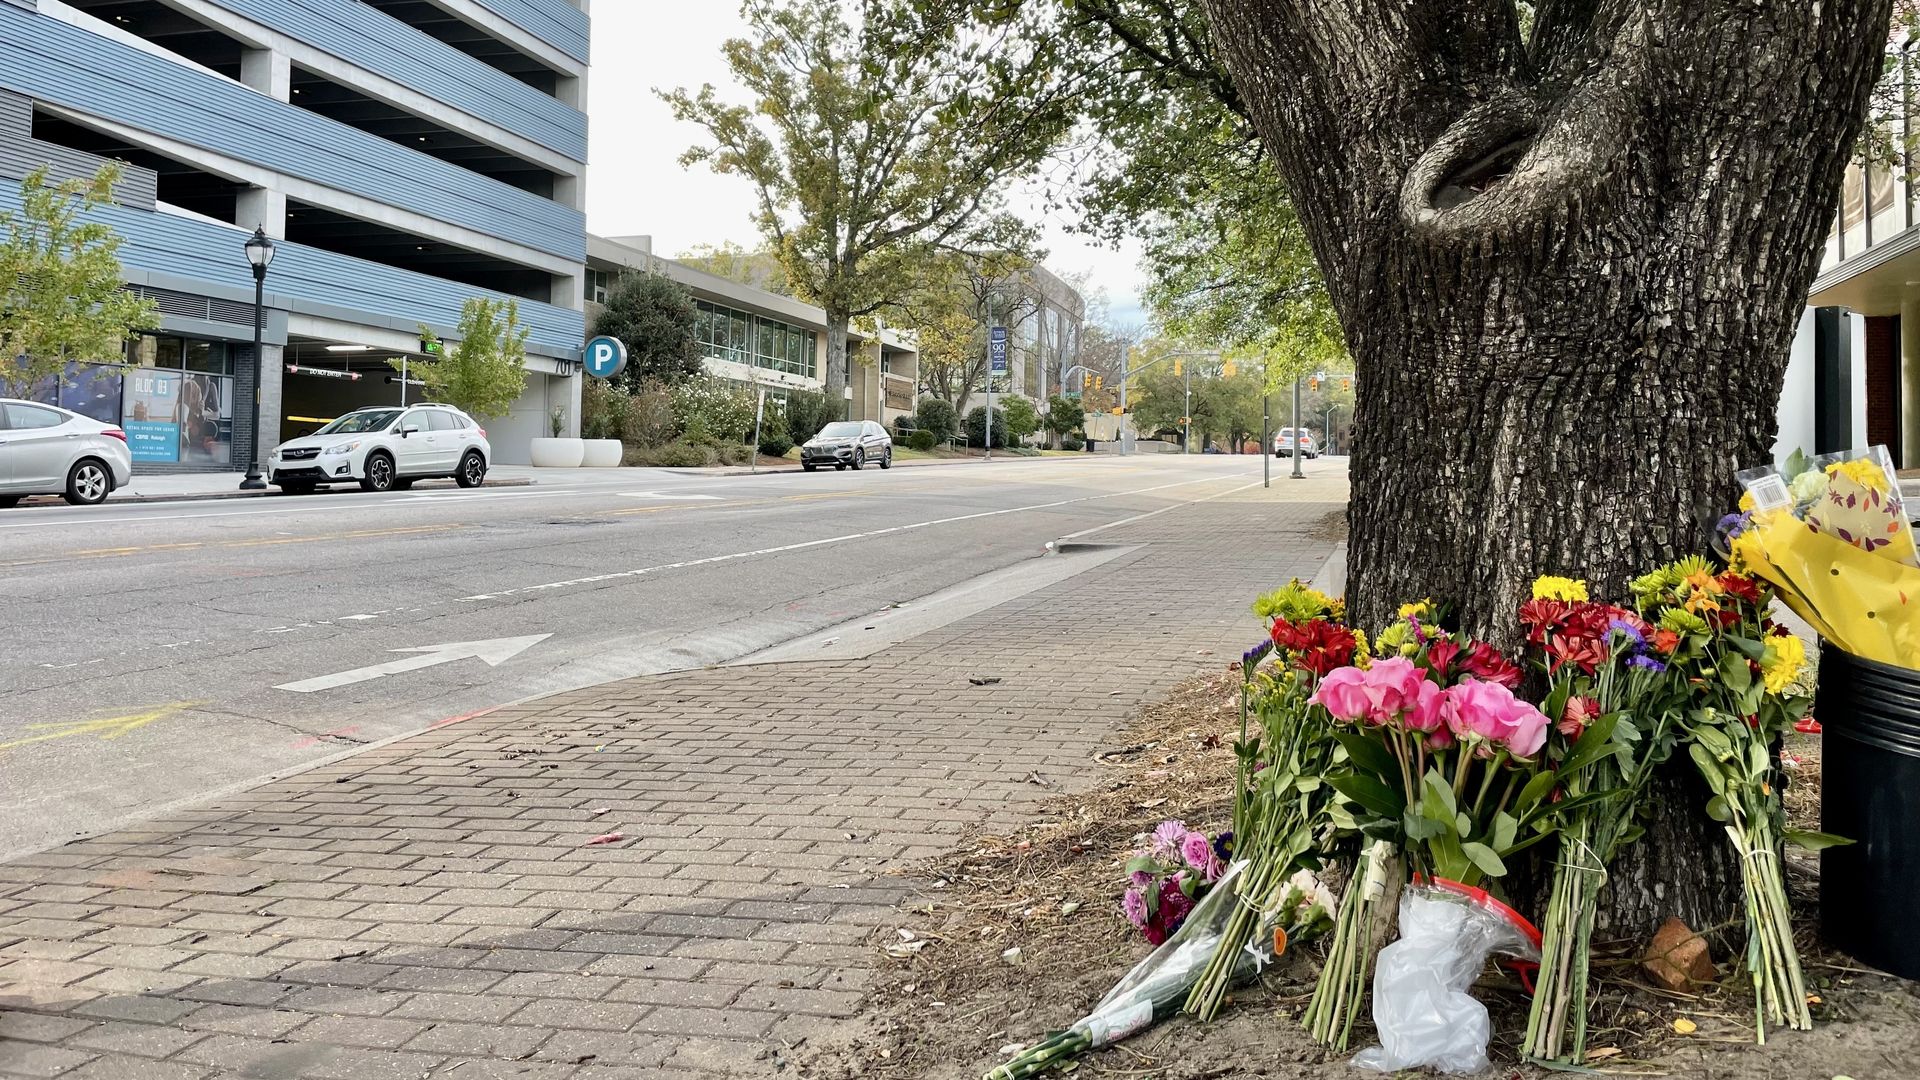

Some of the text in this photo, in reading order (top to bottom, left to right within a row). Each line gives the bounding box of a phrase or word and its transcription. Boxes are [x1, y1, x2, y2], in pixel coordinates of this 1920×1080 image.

[595, 344, 613, 370] P
[993, 344, 1006, 354] 90
[555, 359, 571, 376] 701
[135, 377, 154, 392] BLOC
